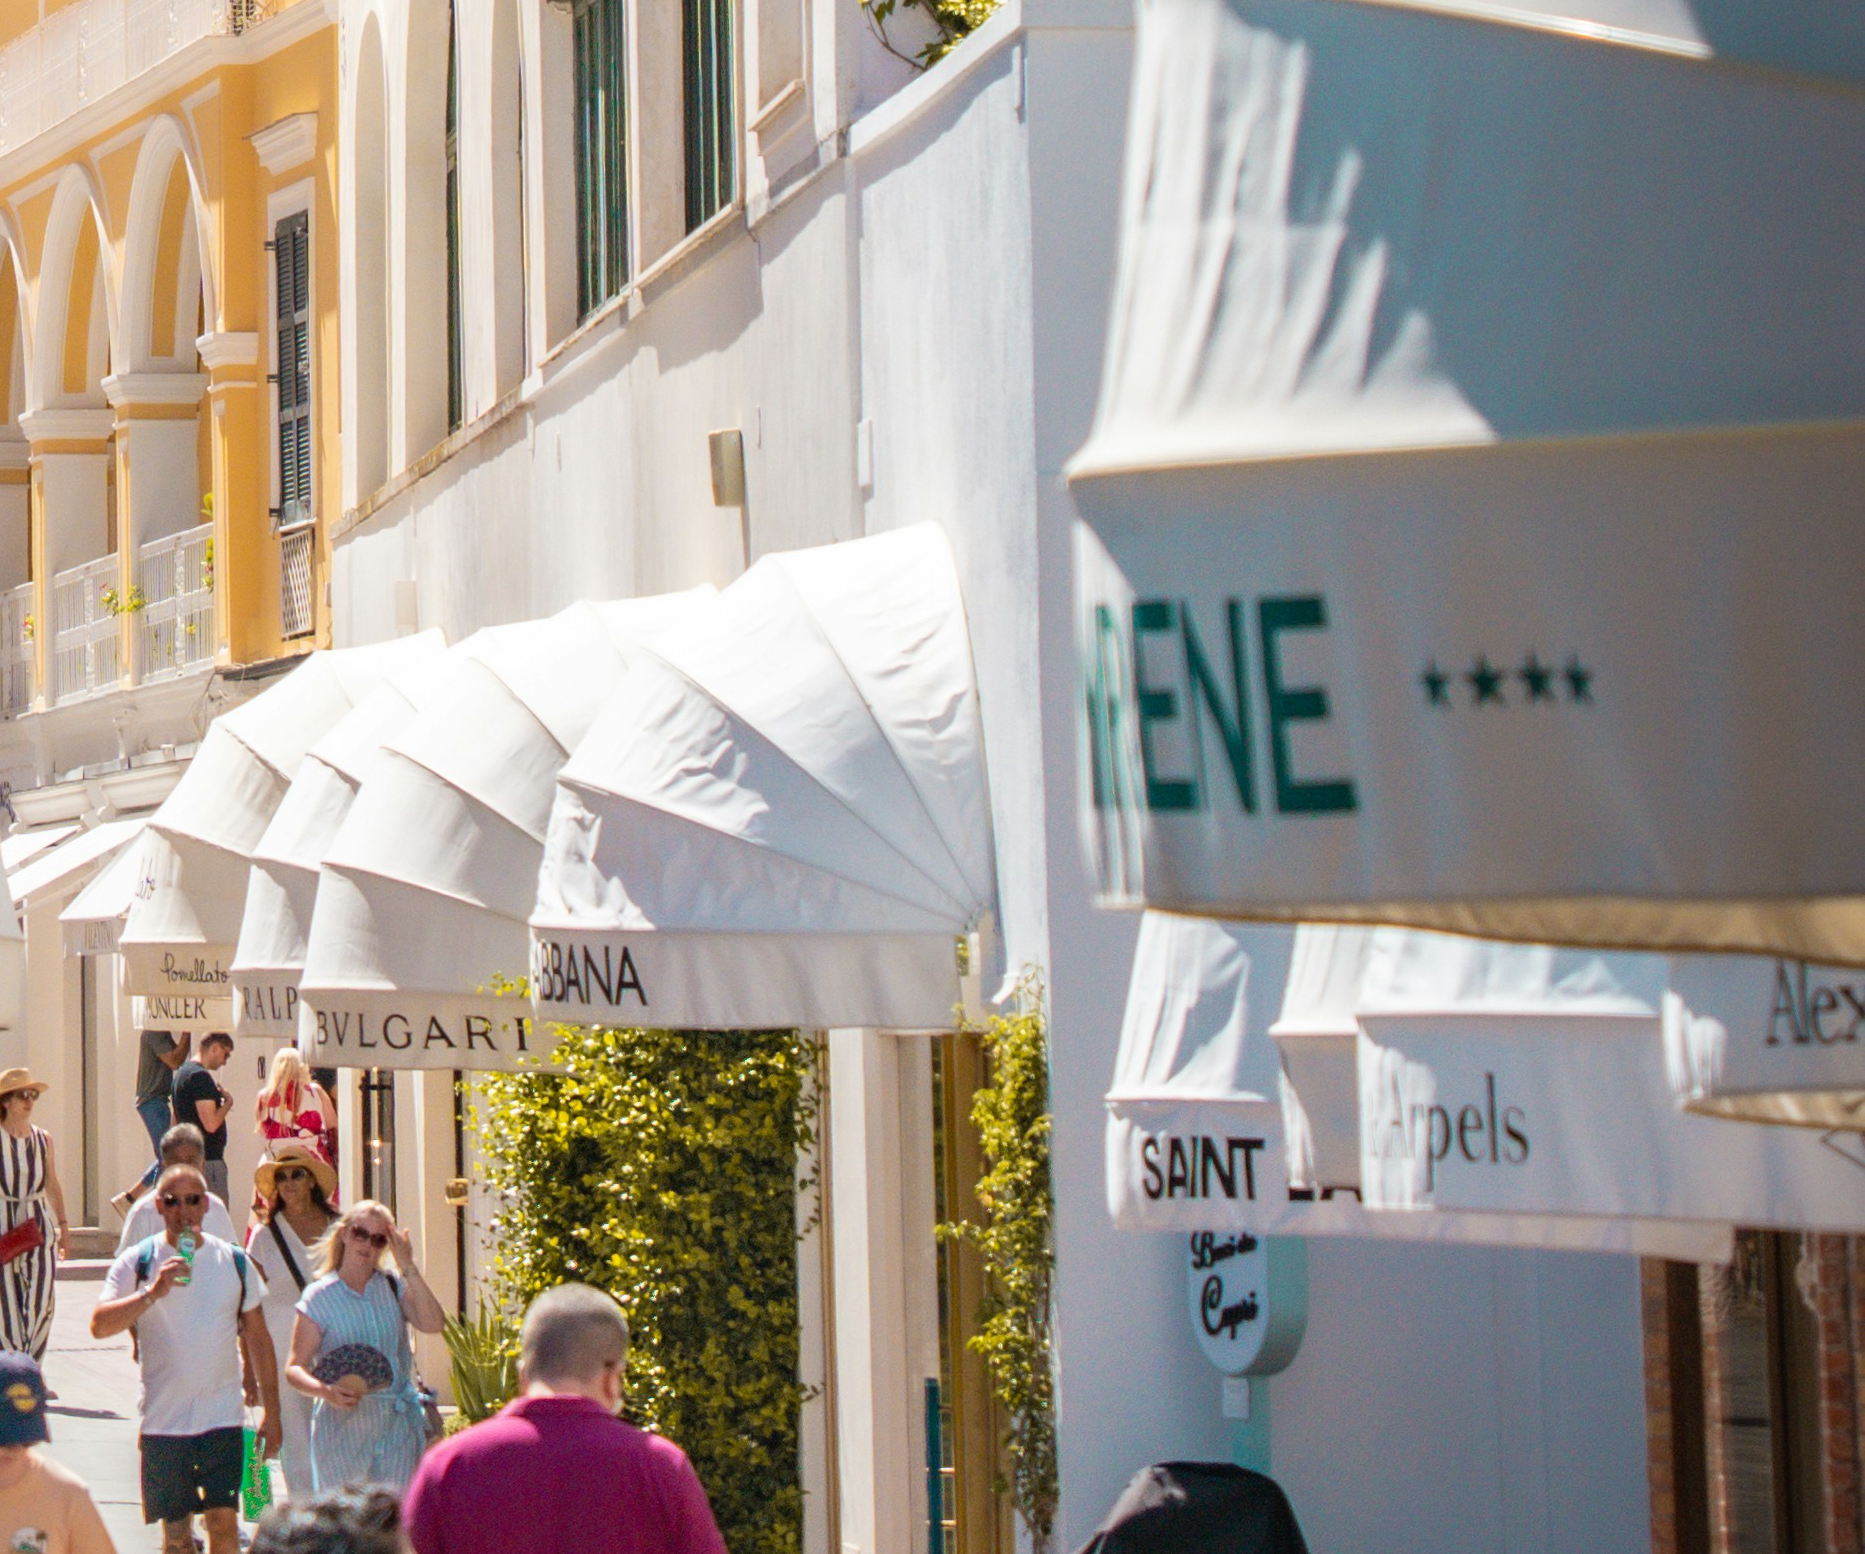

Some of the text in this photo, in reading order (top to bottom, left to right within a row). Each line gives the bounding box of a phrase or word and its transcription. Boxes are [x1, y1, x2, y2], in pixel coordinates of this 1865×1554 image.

[160, 952, 231, 983] Pomellato
[316, 1010, 528, 1051] BVLGARI
[1142, 1135, 1265, 1200] SAINT
